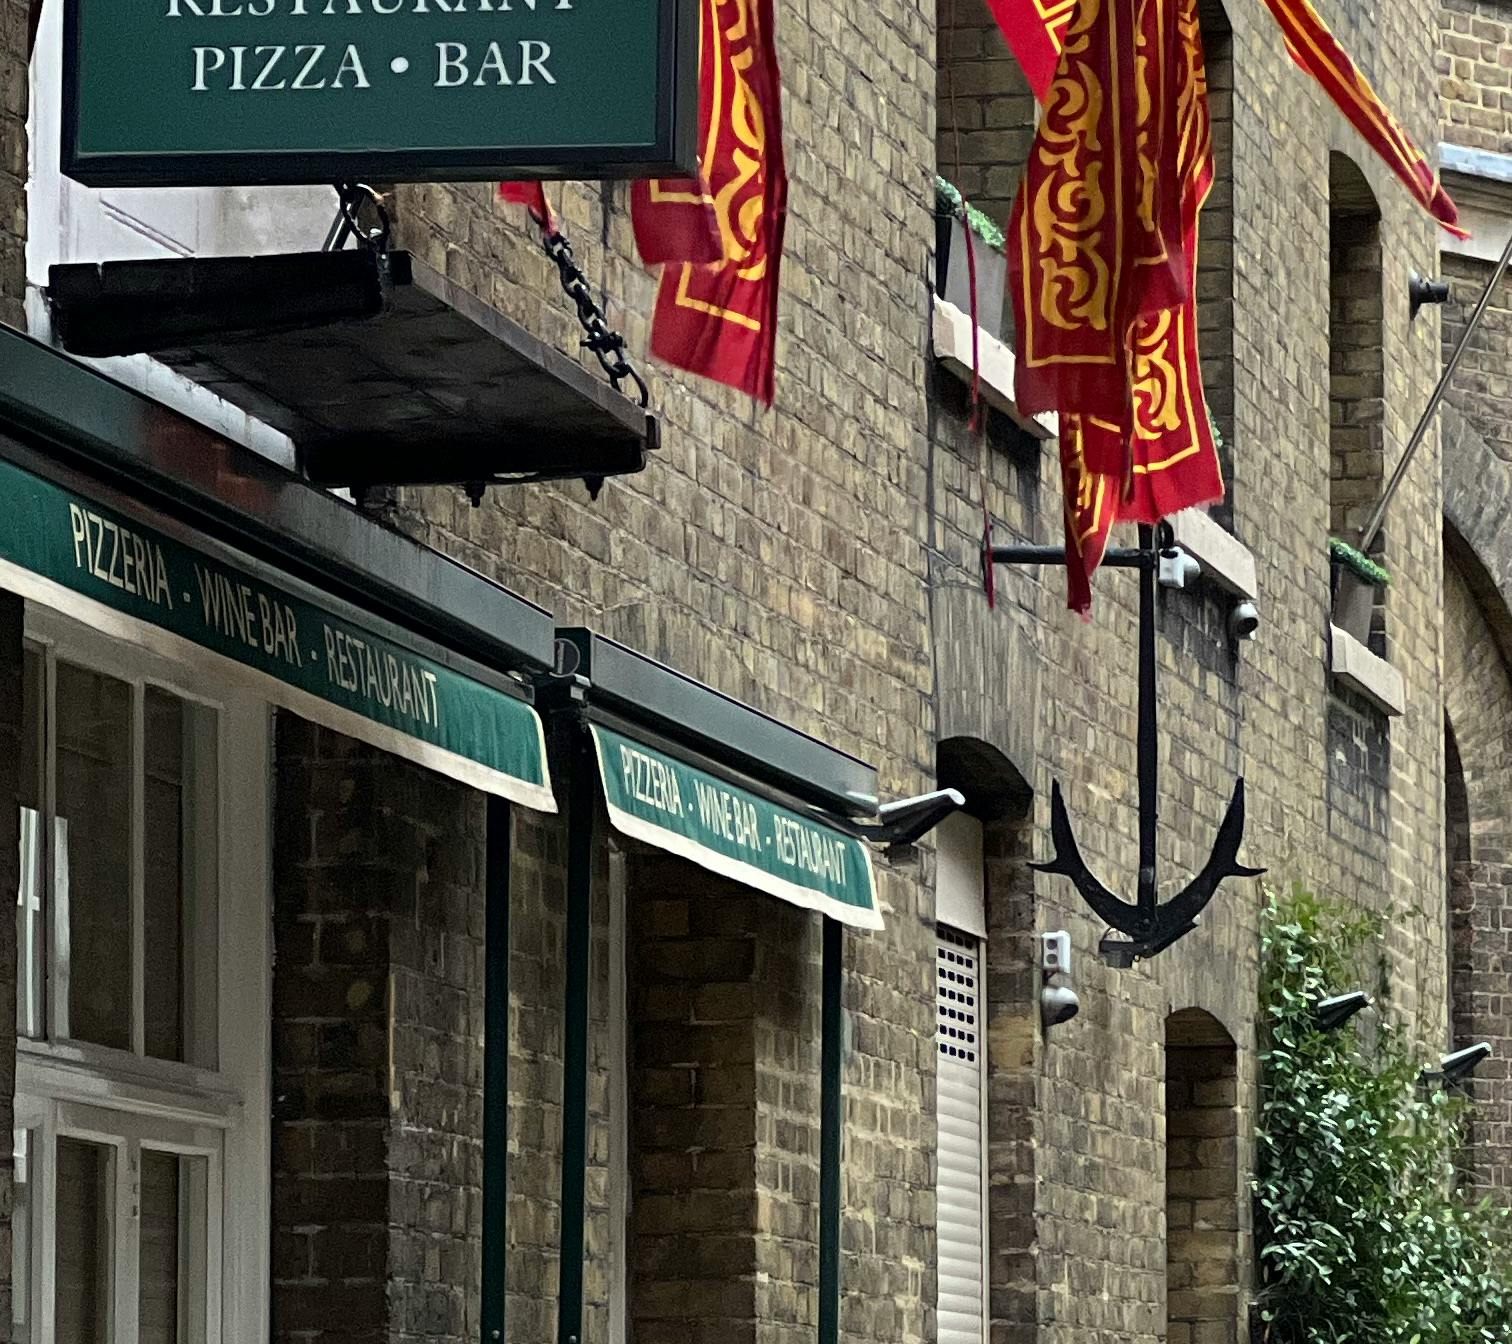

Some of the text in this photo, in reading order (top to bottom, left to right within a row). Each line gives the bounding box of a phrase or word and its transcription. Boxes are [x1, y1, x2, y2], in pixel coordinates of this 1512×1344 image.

[191, 40, 557, 91] PIZZA BAR
[69, 503, 439, 728] PIZZERIA WINE BAR RESTAURANT
[620, 743, 847, 886] PIZZERIA WINE BAR RESTAURANT
